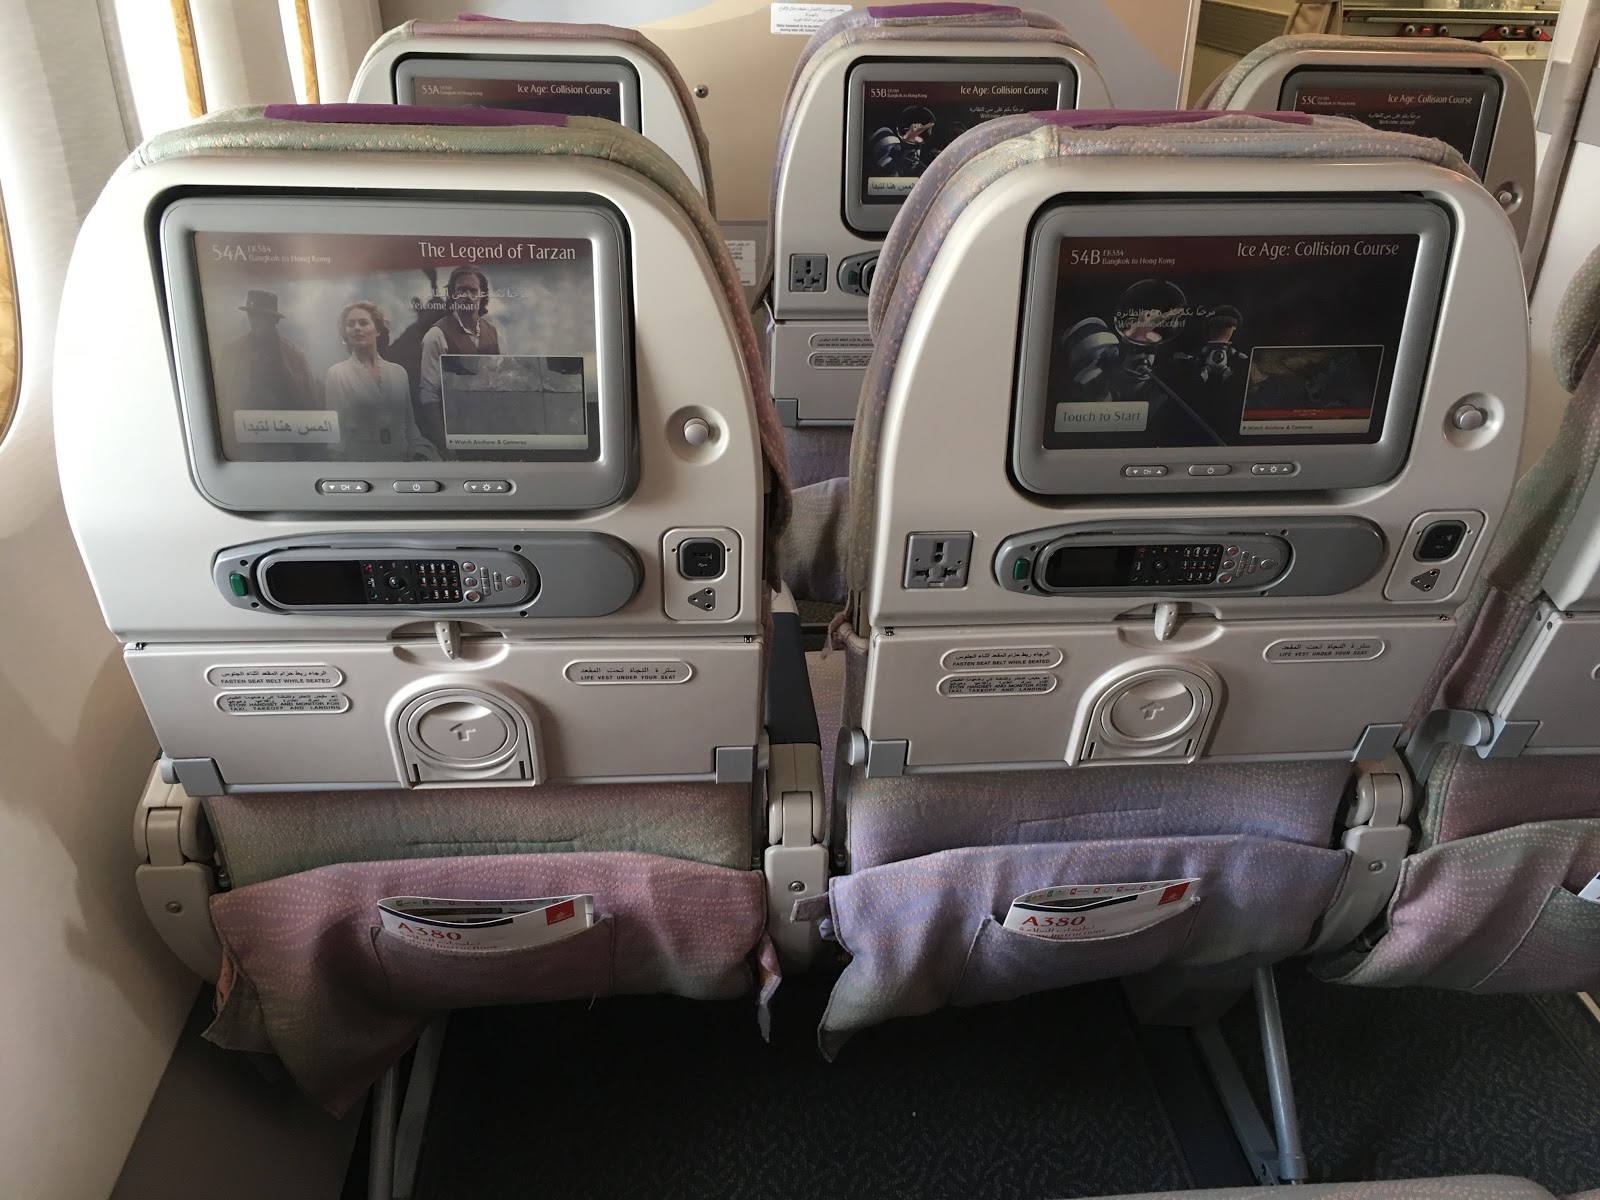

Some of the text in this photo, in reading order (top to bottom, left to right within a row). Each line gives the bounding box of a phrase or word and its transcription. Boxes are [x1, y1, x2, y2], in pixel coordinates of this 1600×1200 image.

[421, 84, 440, 95] 53A
[517, 83, 612, 96] Ice Age: Collision Course
[871, 88, 887, 98] 53B
[960, 85, 1049, 97] Ice Age: Collision Course
[1301, 95, 1318, 105] 53C
[1387, 93, 1473, 105] Ice Age: Collision Course
[212, 244, 248, 262] 54A
[418, 241, 577, 263] The Legend of Tarzan
[1237, 240, 1400, 261] Ice Age: Collision Course
[249, 253, 281, 264] Bangkok
[290, 254, 311, 264] Hong
[312, 255, 331, 265] Kong
[1070, 249, 1101, 265] 54B
[1102, 257, 1131, 267] Bangkok
[1140, 257, 1158, 266] Hong
[1158, 257, 1176, 265] Kong
[449, 301, 481, 311] aboard
[1063, 411, 1141, 422] Touch to Start
[1022, 916, 1086, 927] A380
[398, 922, 462, 940] A380
